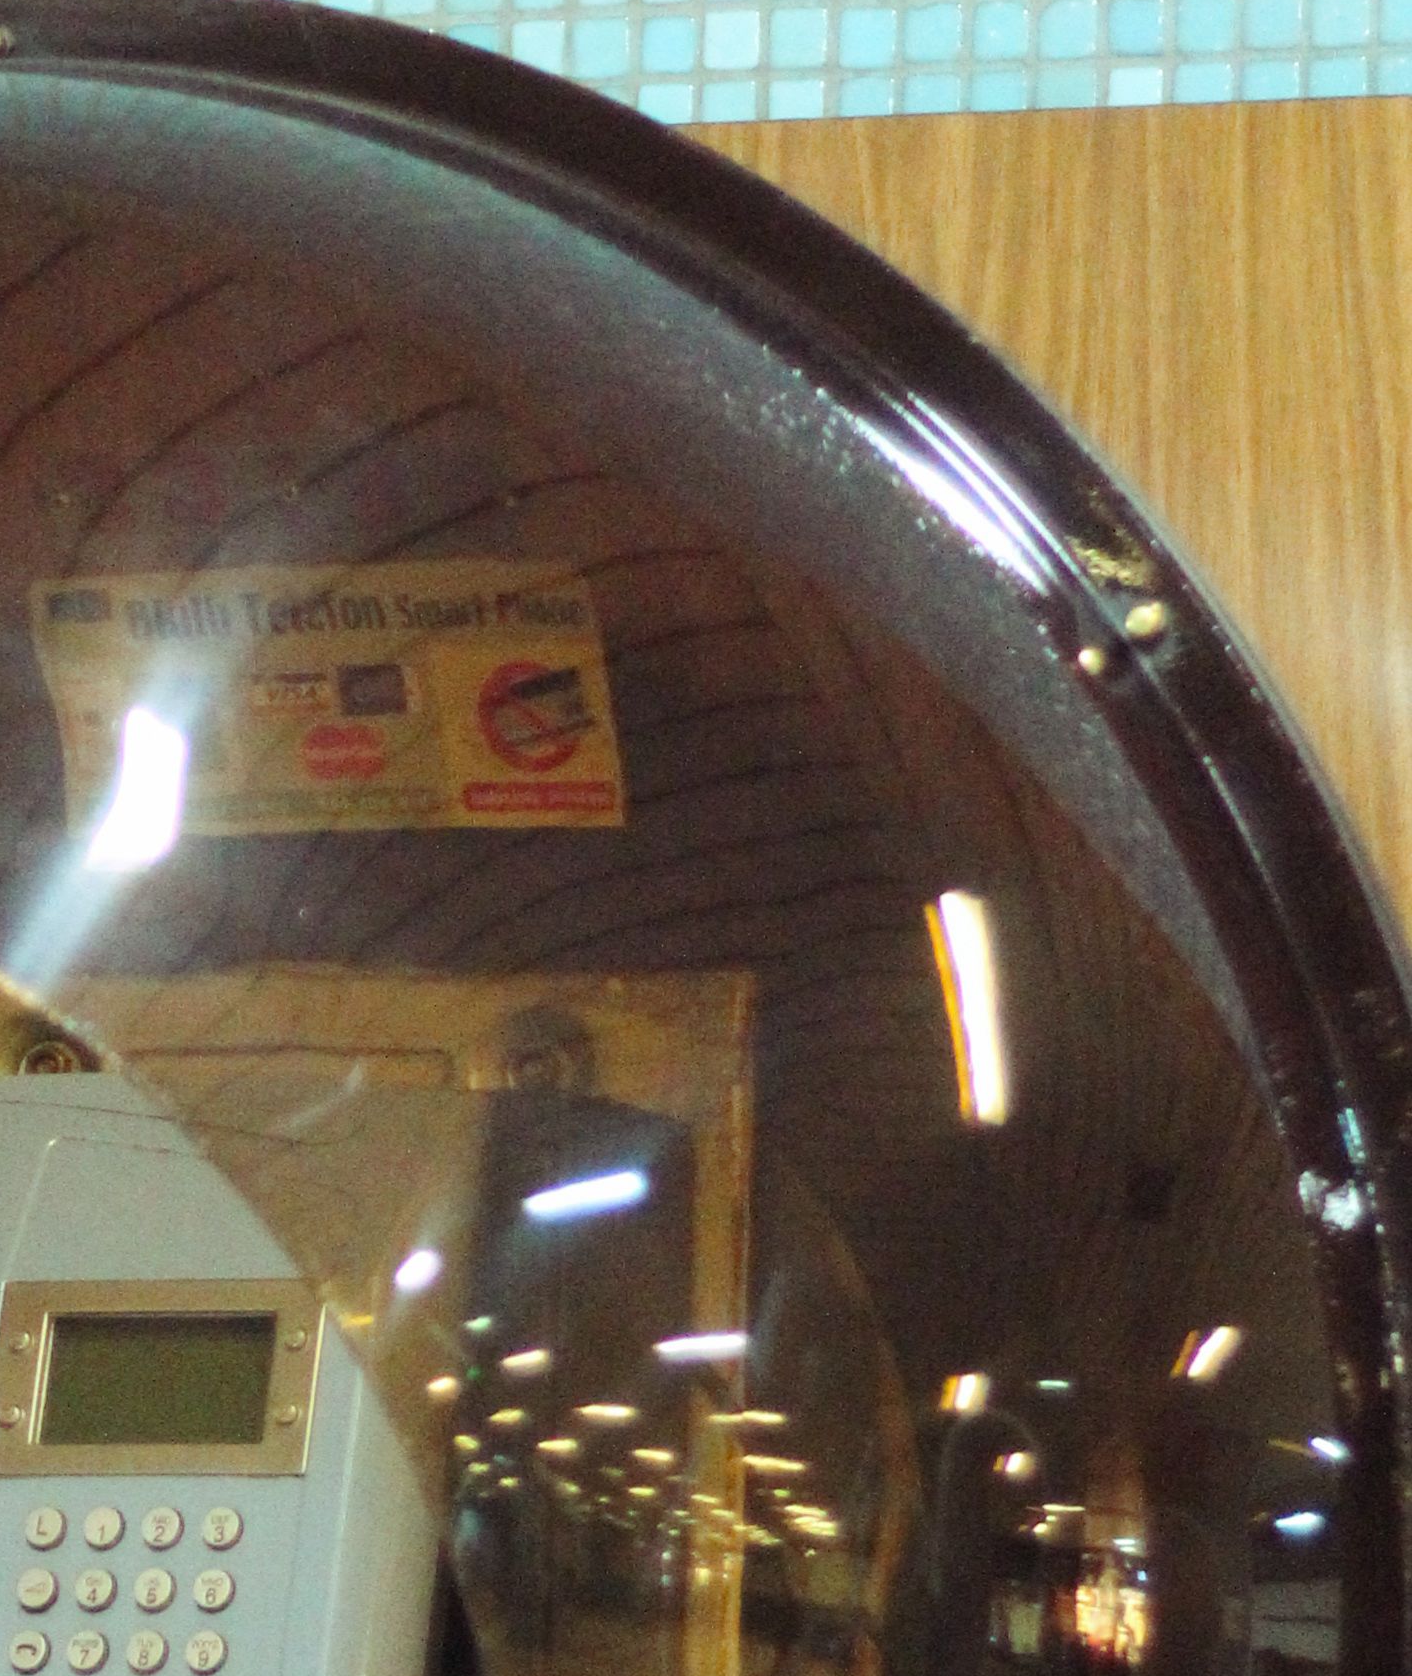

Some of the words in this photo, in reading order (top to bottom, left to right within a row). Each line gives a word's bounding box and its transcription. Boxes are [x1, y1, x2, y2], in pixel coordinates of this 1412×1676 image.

[36, 1515, 47, 1536] L
[154, 1526, 165, 1542] 2
[214, 1526, 225, 1543] 3
[86, 1588, 97, 1604] 4
[146, 1587, 157, 1605] 5
[205, 1588, 216, 1605] 6
[79, 1649, 90, 1666] 7
[138, 1651, 148, 1667] 8
[198, 1651, 209, 1667] 9
